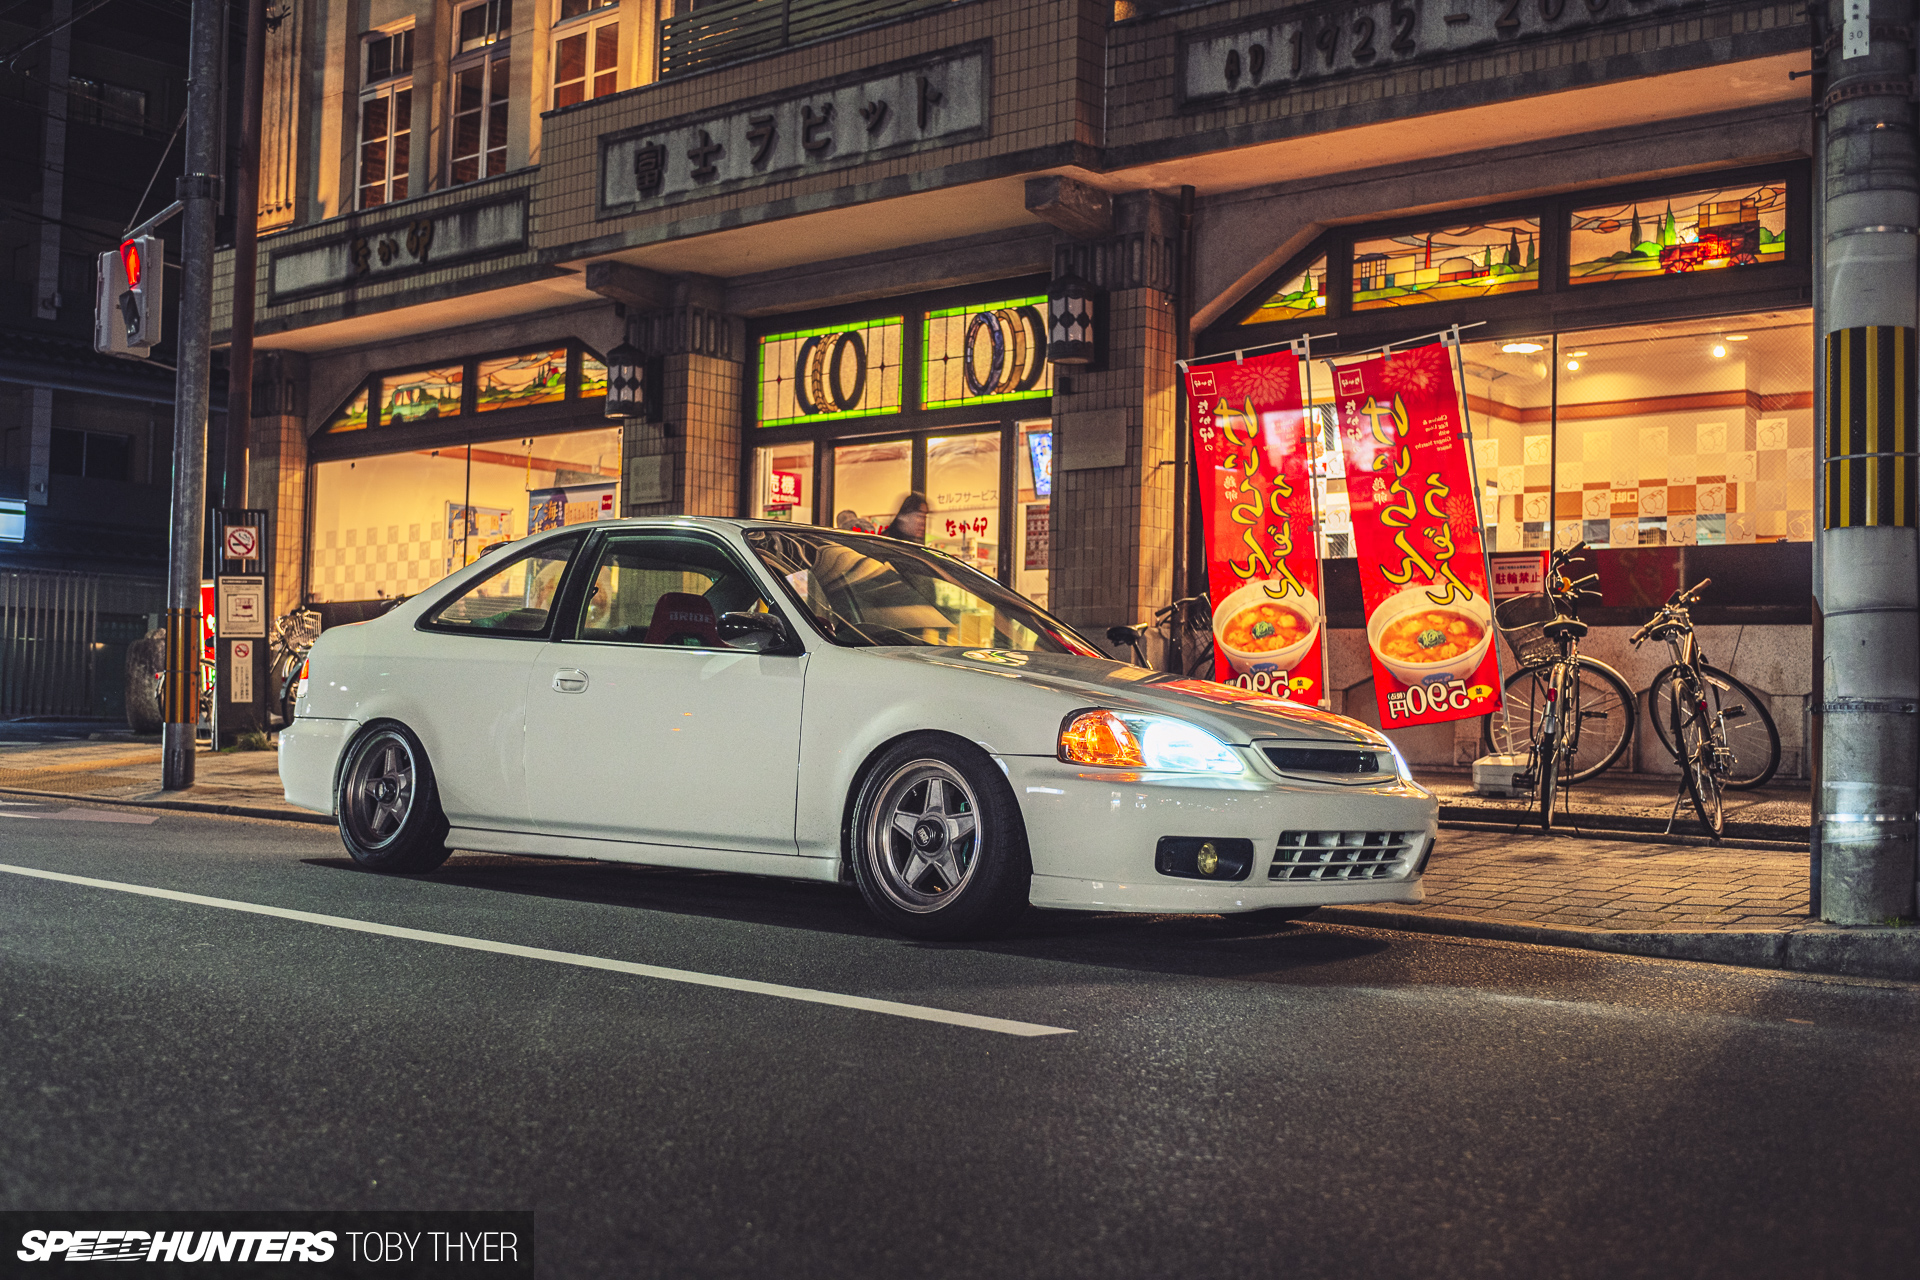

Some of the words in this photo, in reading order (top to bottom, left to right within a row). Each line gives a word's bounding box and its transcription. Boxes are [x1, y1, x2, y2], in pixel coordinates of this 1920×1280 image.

[1848, 30, 1864, 40] 30
[633, 75, 944, 193] 富士ラビット
[937, 490, 998, 505] セルフサービス
[945, 517, 988, 537] なか卯
[1495, 571, 1541, 585] 駐輪禁止
[669, 611, 712, 623] BRIDE
